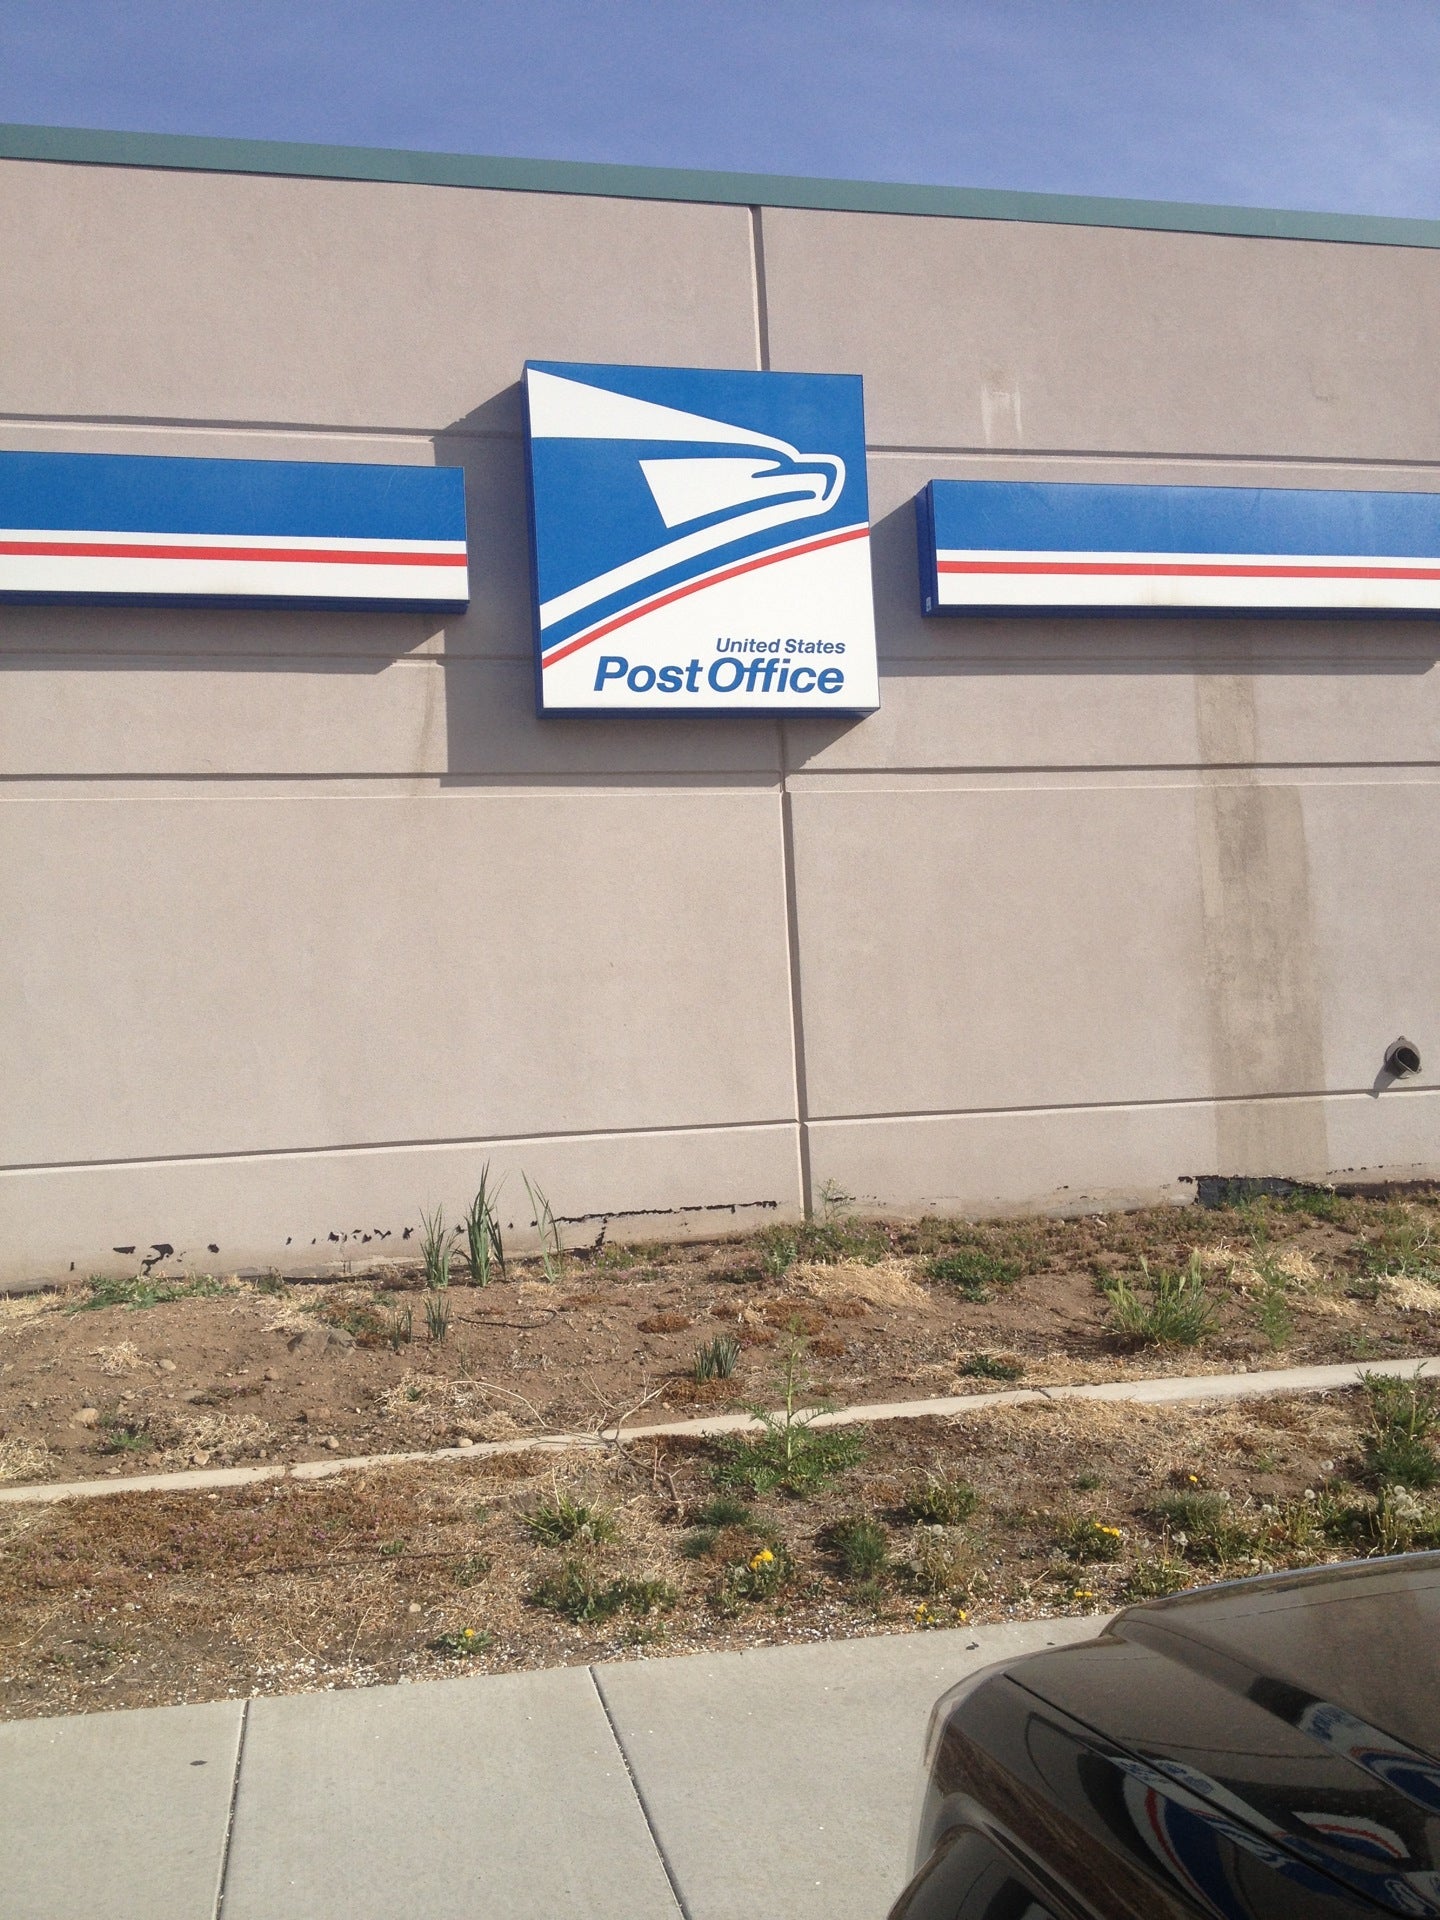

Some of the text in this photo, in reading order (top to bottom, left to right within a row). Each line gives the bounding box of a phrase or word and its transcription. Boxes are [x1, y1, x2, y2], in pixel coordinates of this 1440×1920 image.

[716, 637, 846, 655] United States
[593, 655, 845, 695] Post Office
